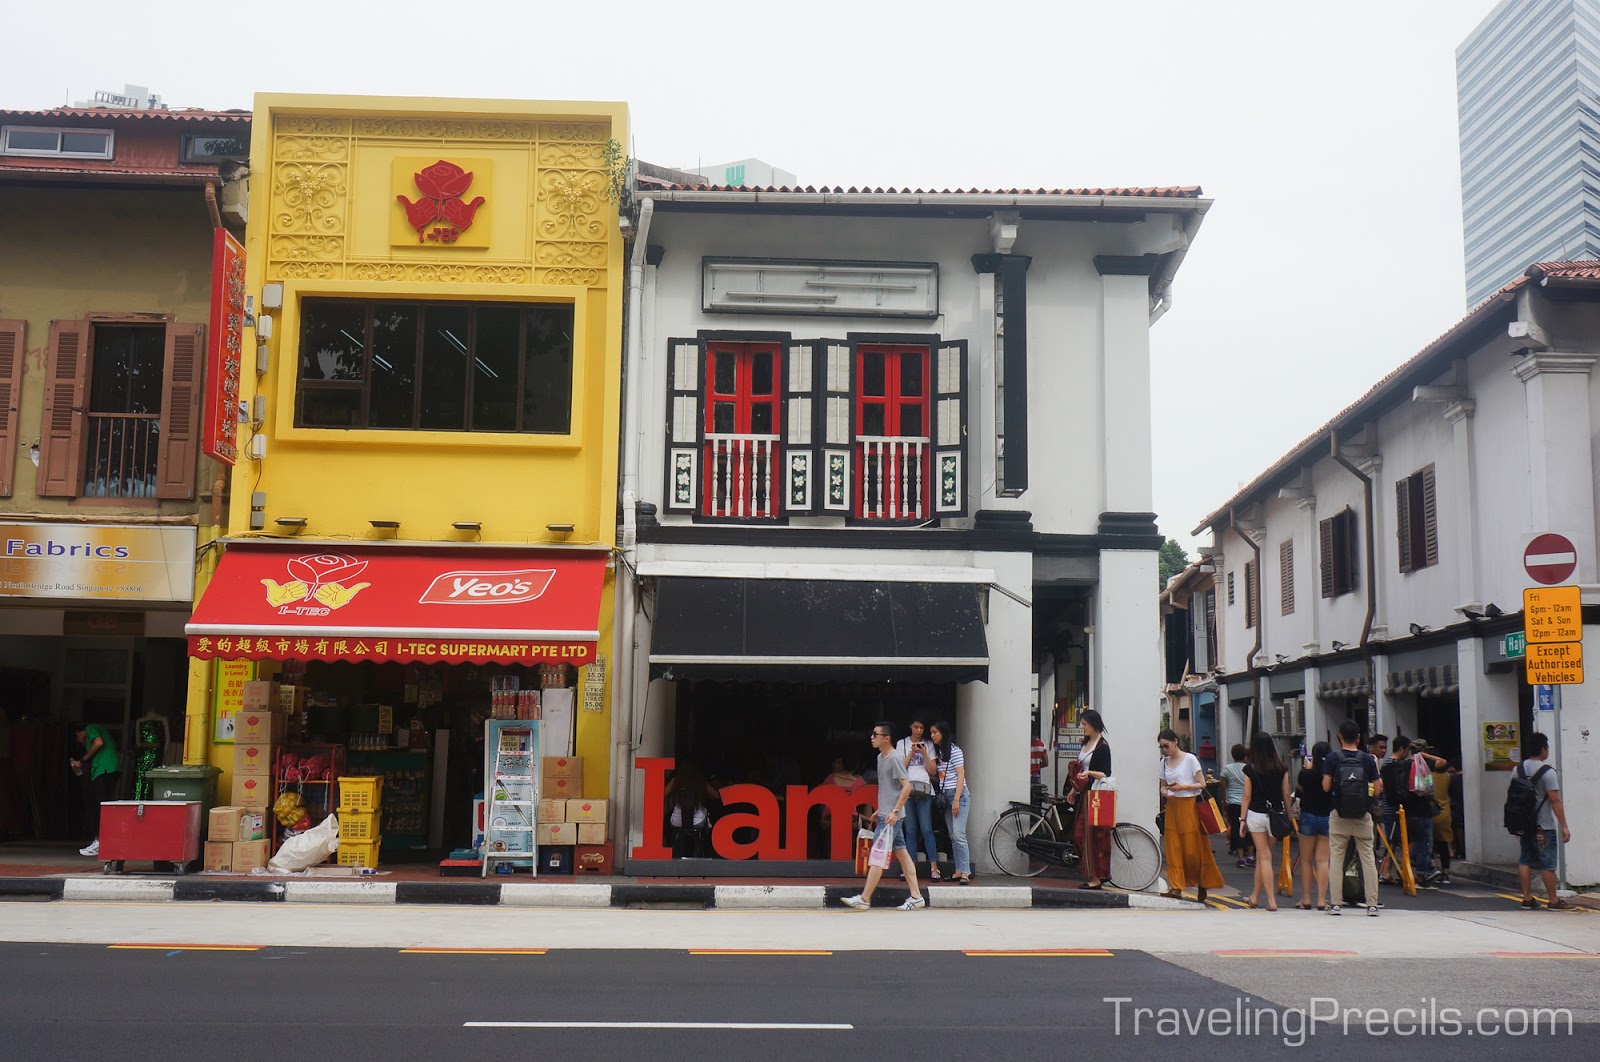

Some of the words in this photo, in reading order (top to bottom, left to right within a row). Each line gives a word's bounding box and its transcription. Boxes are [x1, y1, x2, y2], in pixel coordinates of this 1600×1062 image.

[418, 227, 458, 242] I-TEC
[6, 540, 129, 558] Fabrics
[3, 581, 26, 589] North
[28, 582, 53, 591] Bridge
[55, 583, 75, 591] Road
[77, 583, 114, 593] Singapore
[448, 578, 532, 598] Yeo's
[1529, 593, 1540, 602] Fri
[278, 606, 330, 616] I-TEC
[1531, 617, 1544, 625] Sat
[1557, 616, 1571, 625] Sun
[197, 637, 388, 656] 愛的超級市場有限公司
[397, 643, 437, 655] I-TEC
[439, 643, 529, 657] SUPERMART
[531, 645, 558, 657] PTE
[562, 645, 588, 657] LTD
[1508, 634, 1525, 653] Haji
[1537, 645, 1570, 658] Except
[1528, 658, 1582, 669] Authorised
[1535, 672, 1575, 683] Vehicles
[711, 783, 900, 861] am
